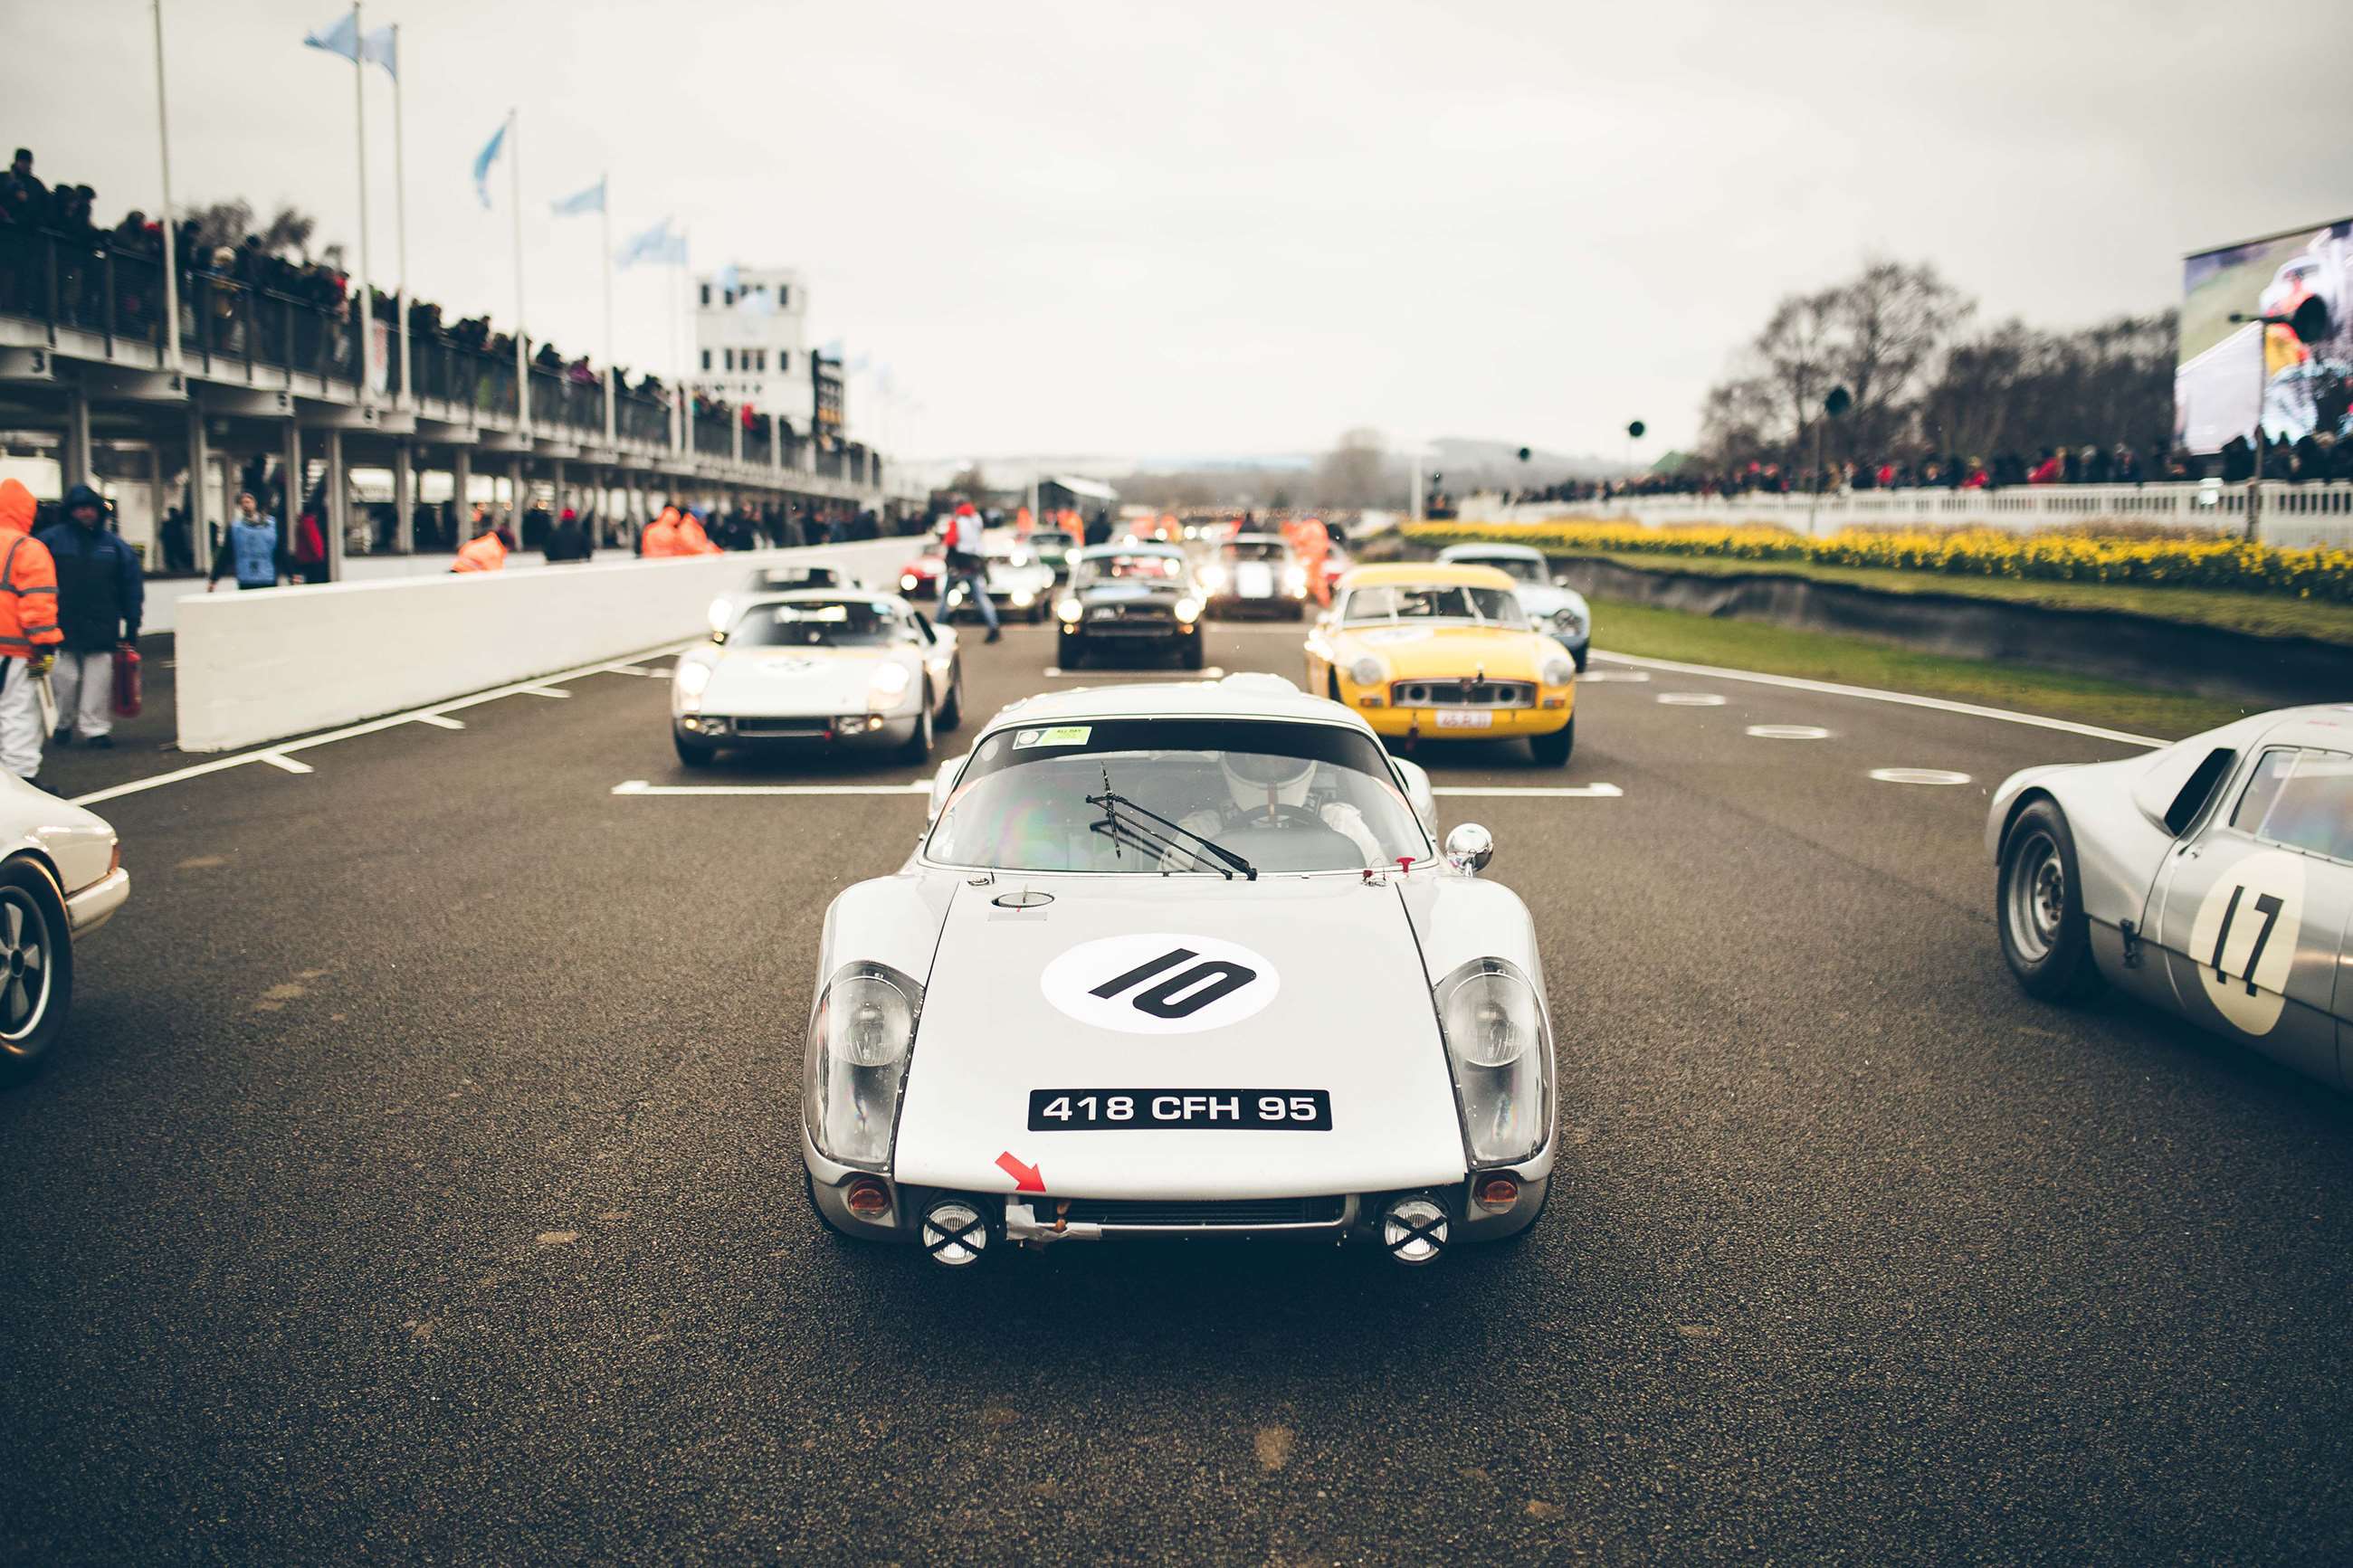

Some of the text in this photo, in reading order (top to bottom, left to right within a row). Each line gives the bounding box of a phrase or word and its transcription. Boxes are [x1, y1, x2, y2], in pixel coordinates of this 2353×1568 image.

[29, 349, 45, 374] 3
[2211, 885, 2285, 997] 17
[1088, 948, 1257, 1019] 10
[1043, 1096, 1318, 1121] 418 CFH 95
